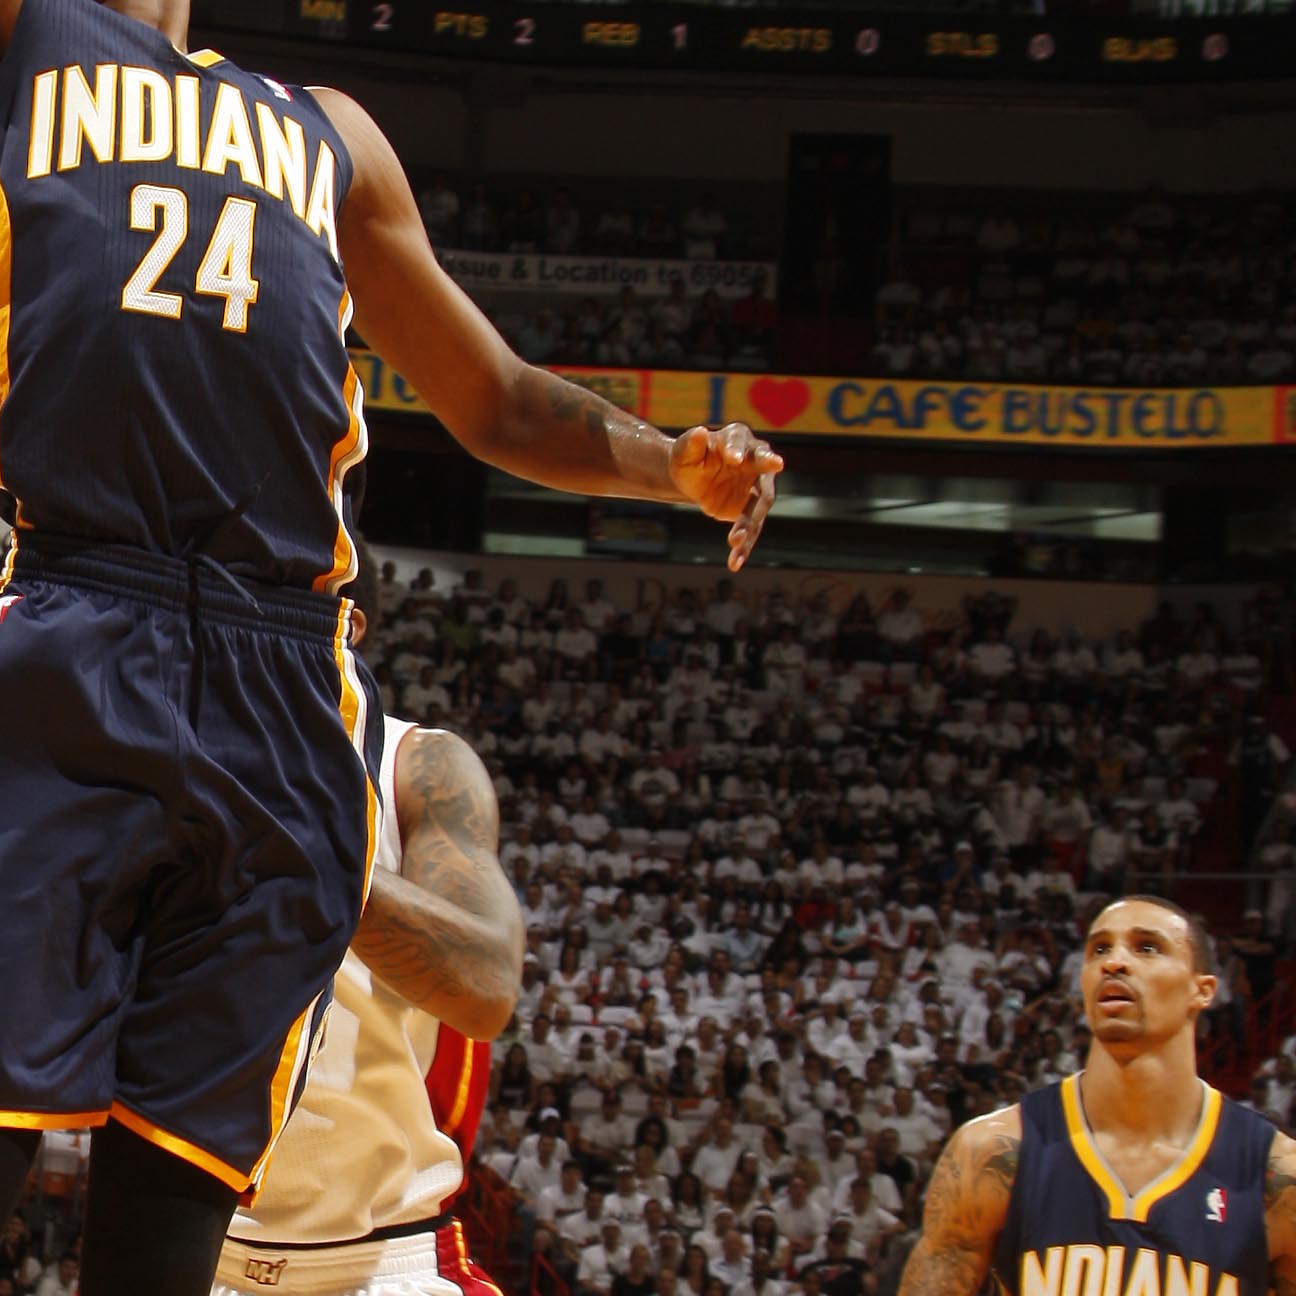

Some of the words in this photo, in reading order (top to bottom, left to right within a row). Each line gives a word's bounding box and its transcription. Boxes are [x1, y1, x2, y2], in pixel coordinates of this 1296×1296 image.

[371, 2, 394, 32] 2
[433, 10, 489, 40] PTS
[513, 18, 536, 47] 2
[668, 22, 688, 52] 1
[740, 24, 832, 54] ASSTS
[27, 64, 339, 263] INDIANA
[121, 183, 259, 333] 24
[539, 259, 648, 285] Location
[1000, 388, 1224, 439] BUSTELO
